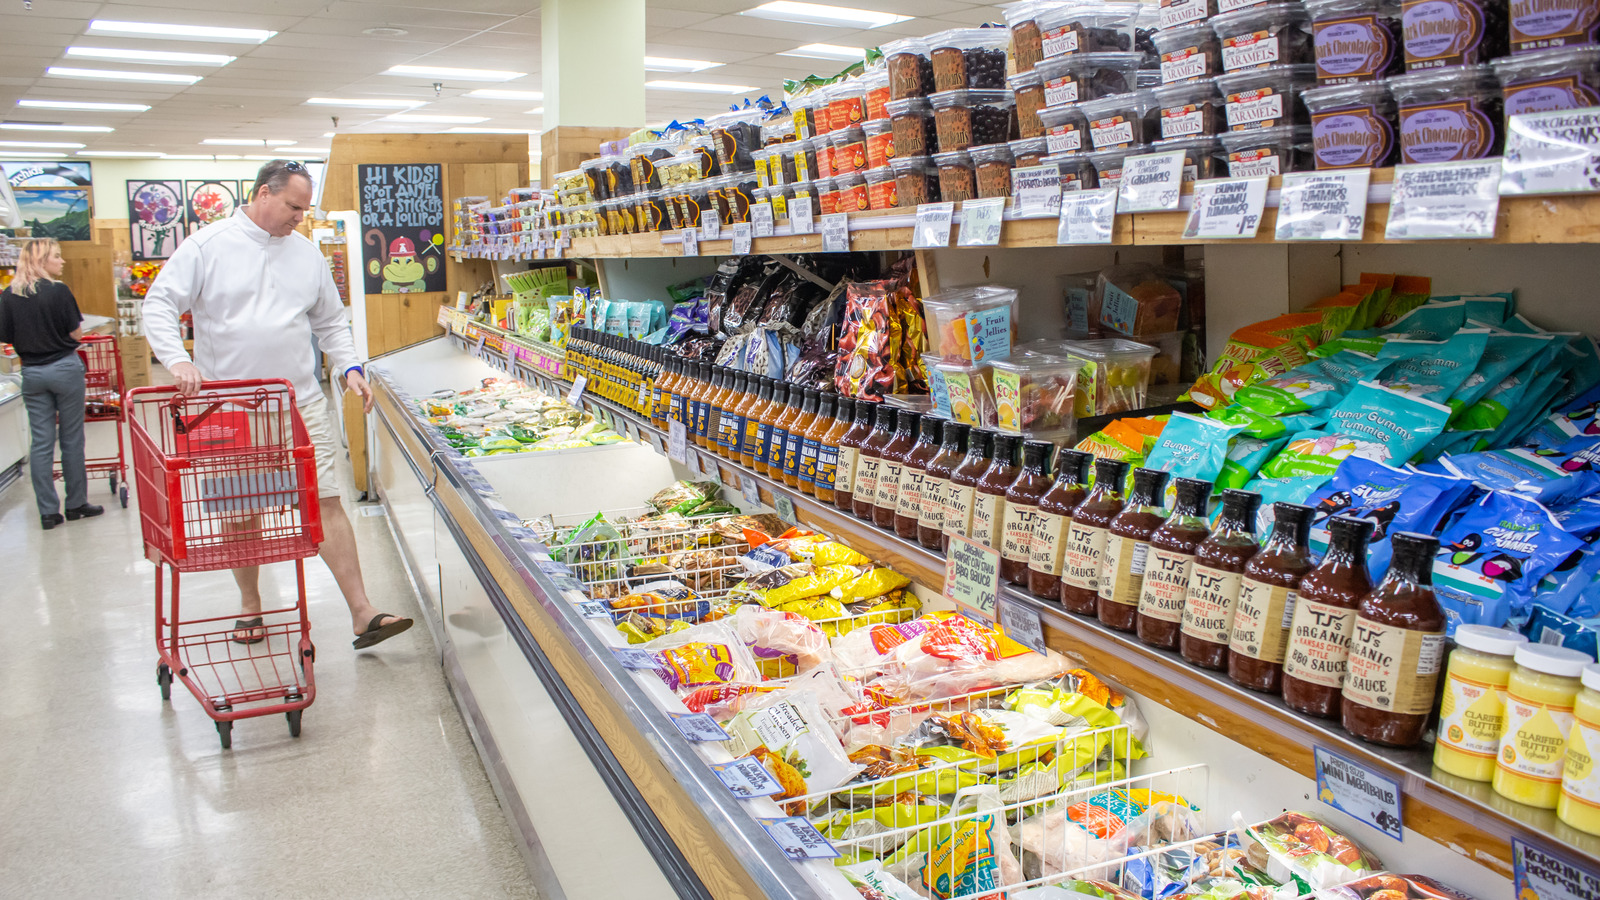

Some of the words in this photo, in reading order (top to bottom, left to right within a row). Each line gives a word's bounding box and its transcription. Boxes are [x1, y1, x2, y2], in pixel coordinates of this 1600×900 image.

[1161, 7, 1204, 25] CARAMELS
[1419, 17, 1459, 36] Chocolate
[1045, 41, 1076, 56] ARAMELS
[1333, 38, 1373, 55] Chocolate
[1225, 48, 1275, 67] CARAMELS
[1047, 92, 1075, 105] ARAMELS
[1229, 107, 1279, 123] CARAMELS
[1096, 132, 1130, 146] ARAMELS
[1331, 130, 1371, 147] Chocolate
[1422, 126, 1467, 144] Chocolate
[1050, 140, 1077, 152] ARAMELS
[366, 167, 387, 184] HI
[393, 165, 438, 184] KIDS!
[1131, 171, 1170, 185] CARAMELS
[364, 185, 393, 199] SPOT
[395, 181, 438, 199] ANGEL
[1215, 182, 1248, 194] BUNNY
[373, 199, 394, 213] GET
[396, 199, 442, 213] STICKERS
[1209, 193, 1247, 206] GUMMY
[362, 213, 380, 227] OR
[381, 212, 393, 226] A
[396, 212, 443, 227] LOLLIPOP
[986, 316, 1004, 326] Fruit
[985, 327, 1007, 338] Jellies
[1340, 420, 1391, 442] Tummies
[1367, 411, 1414, 440] Gummy
[1162, 439, 1194, 453] Bunny
[858, 470, 877, 478] ORGA
[881, 476, 898, 484] ORGA
[902, 483, 920, 492] ORGA
[924, 512, 944, 520] SAUCE
[973, 530, 988, 538] AUCE
[1007, 523, 1034, 531] ORGA
[1072, 529, 1095, 544] TJ's
[964, 543, 985, 560] ORGANIC
[1068, 542, 1100, 558] RGANIC
[1156, 553, 1187, 574] TJ's
[956, 562, 968, 580] BBQ
[970, 569, 990, 587] SAUCE
[1071, 567, 1096, 577] SAUCE
[1149, 581, 1169, 590] KANSAS
[1171, 585, 1184, 593] CITY
[1196, 571, 1225, 591] TJ's
[1156, 590, 1172, 598] STYLE
[1188, 588, 1230, 608] RGANIC
[1158, 599, 1185, 610] SAUC
[1207, 603, 1220, 612] CITY
[1193, 608, 1208, 617] STYLE
[1307, 606, 1347, 630] TJ's
[1195, 617, 1225, 629] SAUCE
[1297, 626, 1352, 648] ORGANIC
[1357, 626, 1387, 648] TJ's
[1300, 638, 1324, 650] KANSAS
[1326, 644, 1342, 653] CITY
[1292, 649, 1308, 666] BBQ
[1311, 659, 1347, 673] SAUCE
[1308, 649, 1328, 660] STYLE
[1351, 642, 1392, 667] RGANIC
[1352, 666, 1368, 678] STYLE
[1366, 661, 1381, 672] CITY
[1353, 677, 1387, 692] SAUCE
[768, 707, 790, 739] Chicken
[778, 702, 804, 732] Breaded
[1465, 710, 1503, 723] CLARIFIE
[1517, 730, 1563, 746] CLARIFIED
[1520, 740, 1557, 753] BUTTER
[1349, 766, 1364, 779] SIZE
[1322, 761, 1344, 782] MINI
[1346, 773, 1395, 805] MEATBALLS
[1524, 846, 1580, 884] KOREAN
